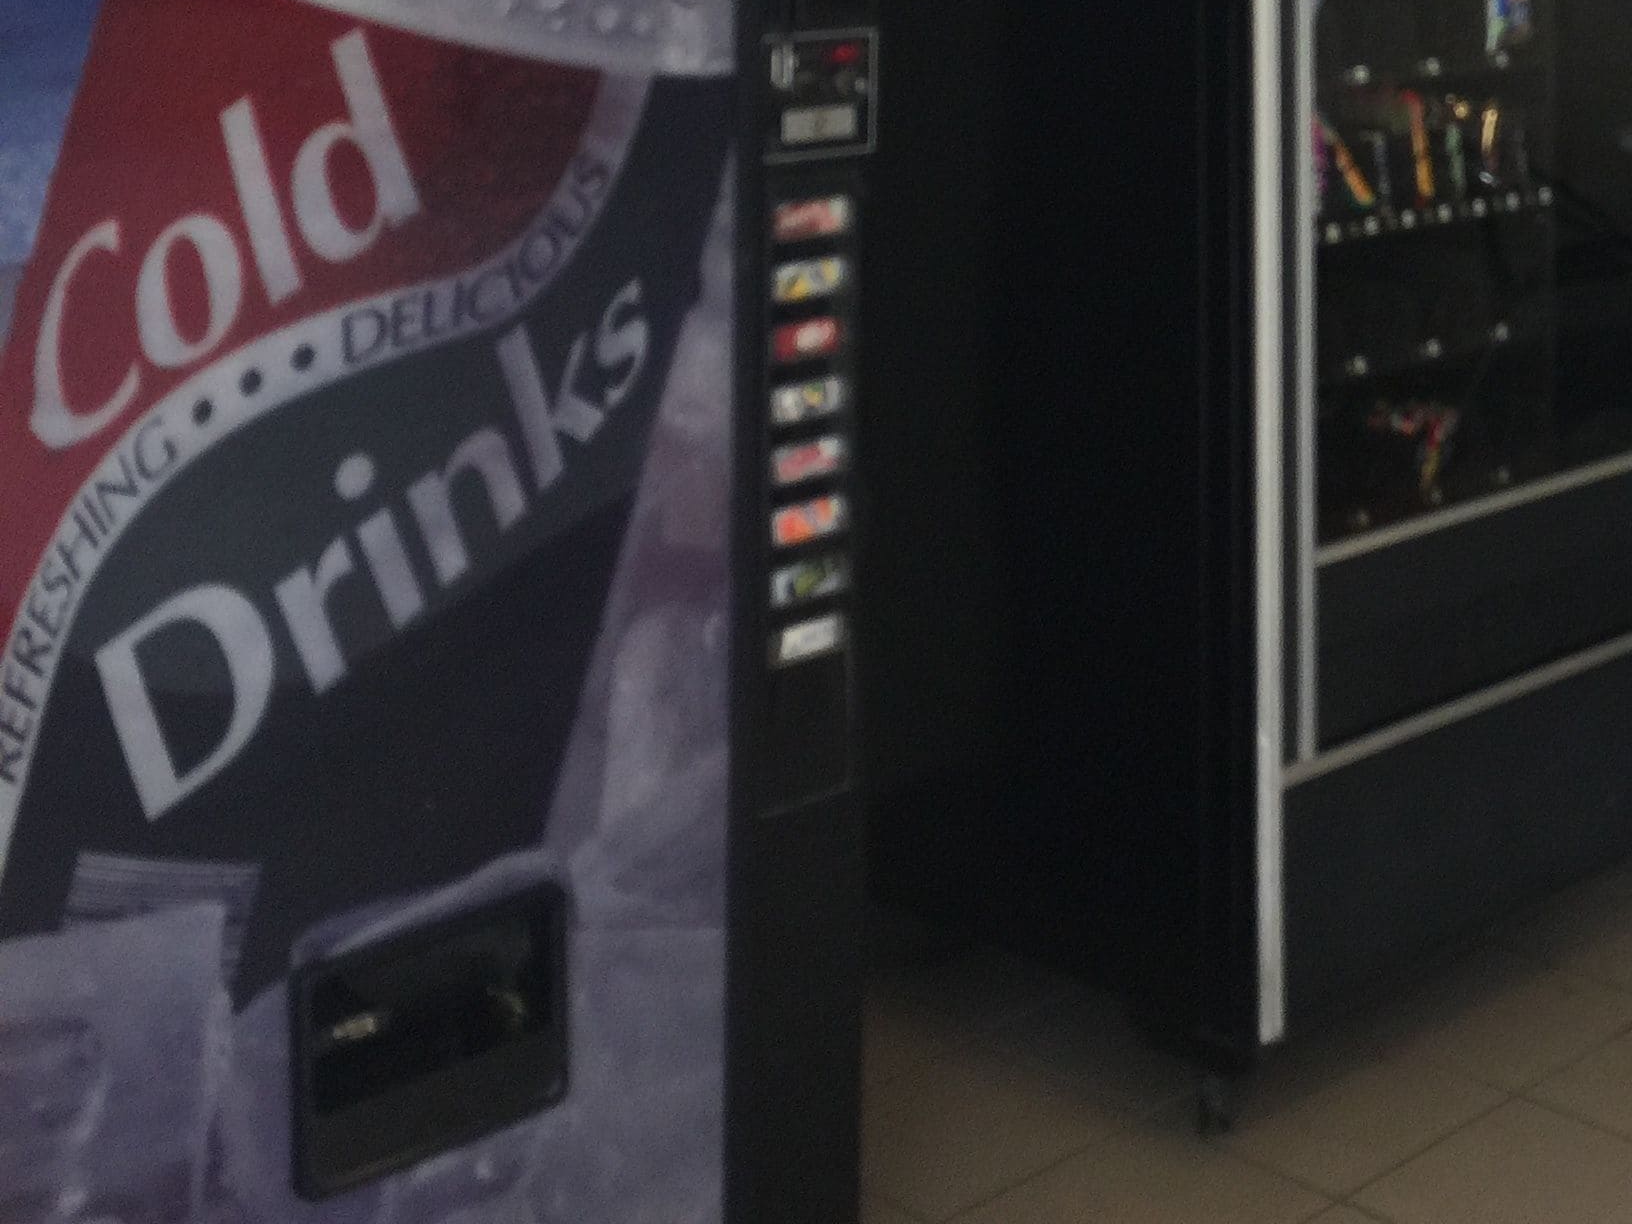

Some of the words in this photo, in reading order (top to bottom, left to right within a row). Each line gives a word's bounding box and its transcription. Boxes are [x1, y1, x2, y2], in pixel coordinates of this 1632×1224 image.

[28, 26, 422, 450] Cold
[341, 158, 606, 364] DELICIOUS
[94, 276, 649, 823] Drinks
